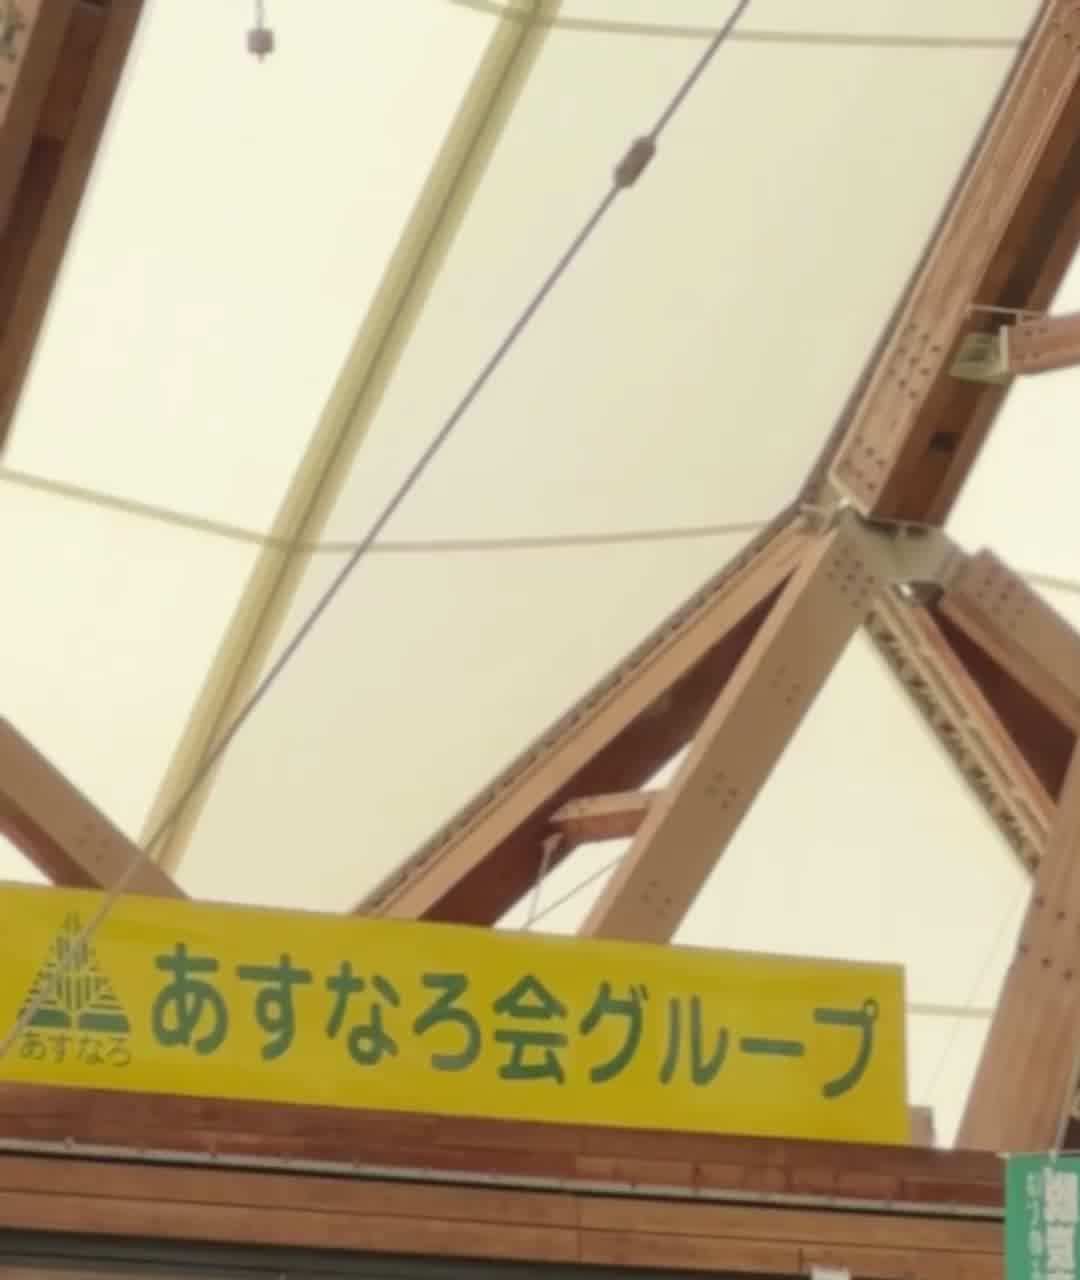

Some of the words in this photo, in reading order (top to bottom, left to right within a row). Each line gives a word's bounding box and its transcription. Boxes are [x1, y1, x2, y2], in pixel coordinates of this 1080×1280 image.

[18, 1030, 132, 1067] あすなろ
[151, 938, 880, 1099] あすなろ会グループ
